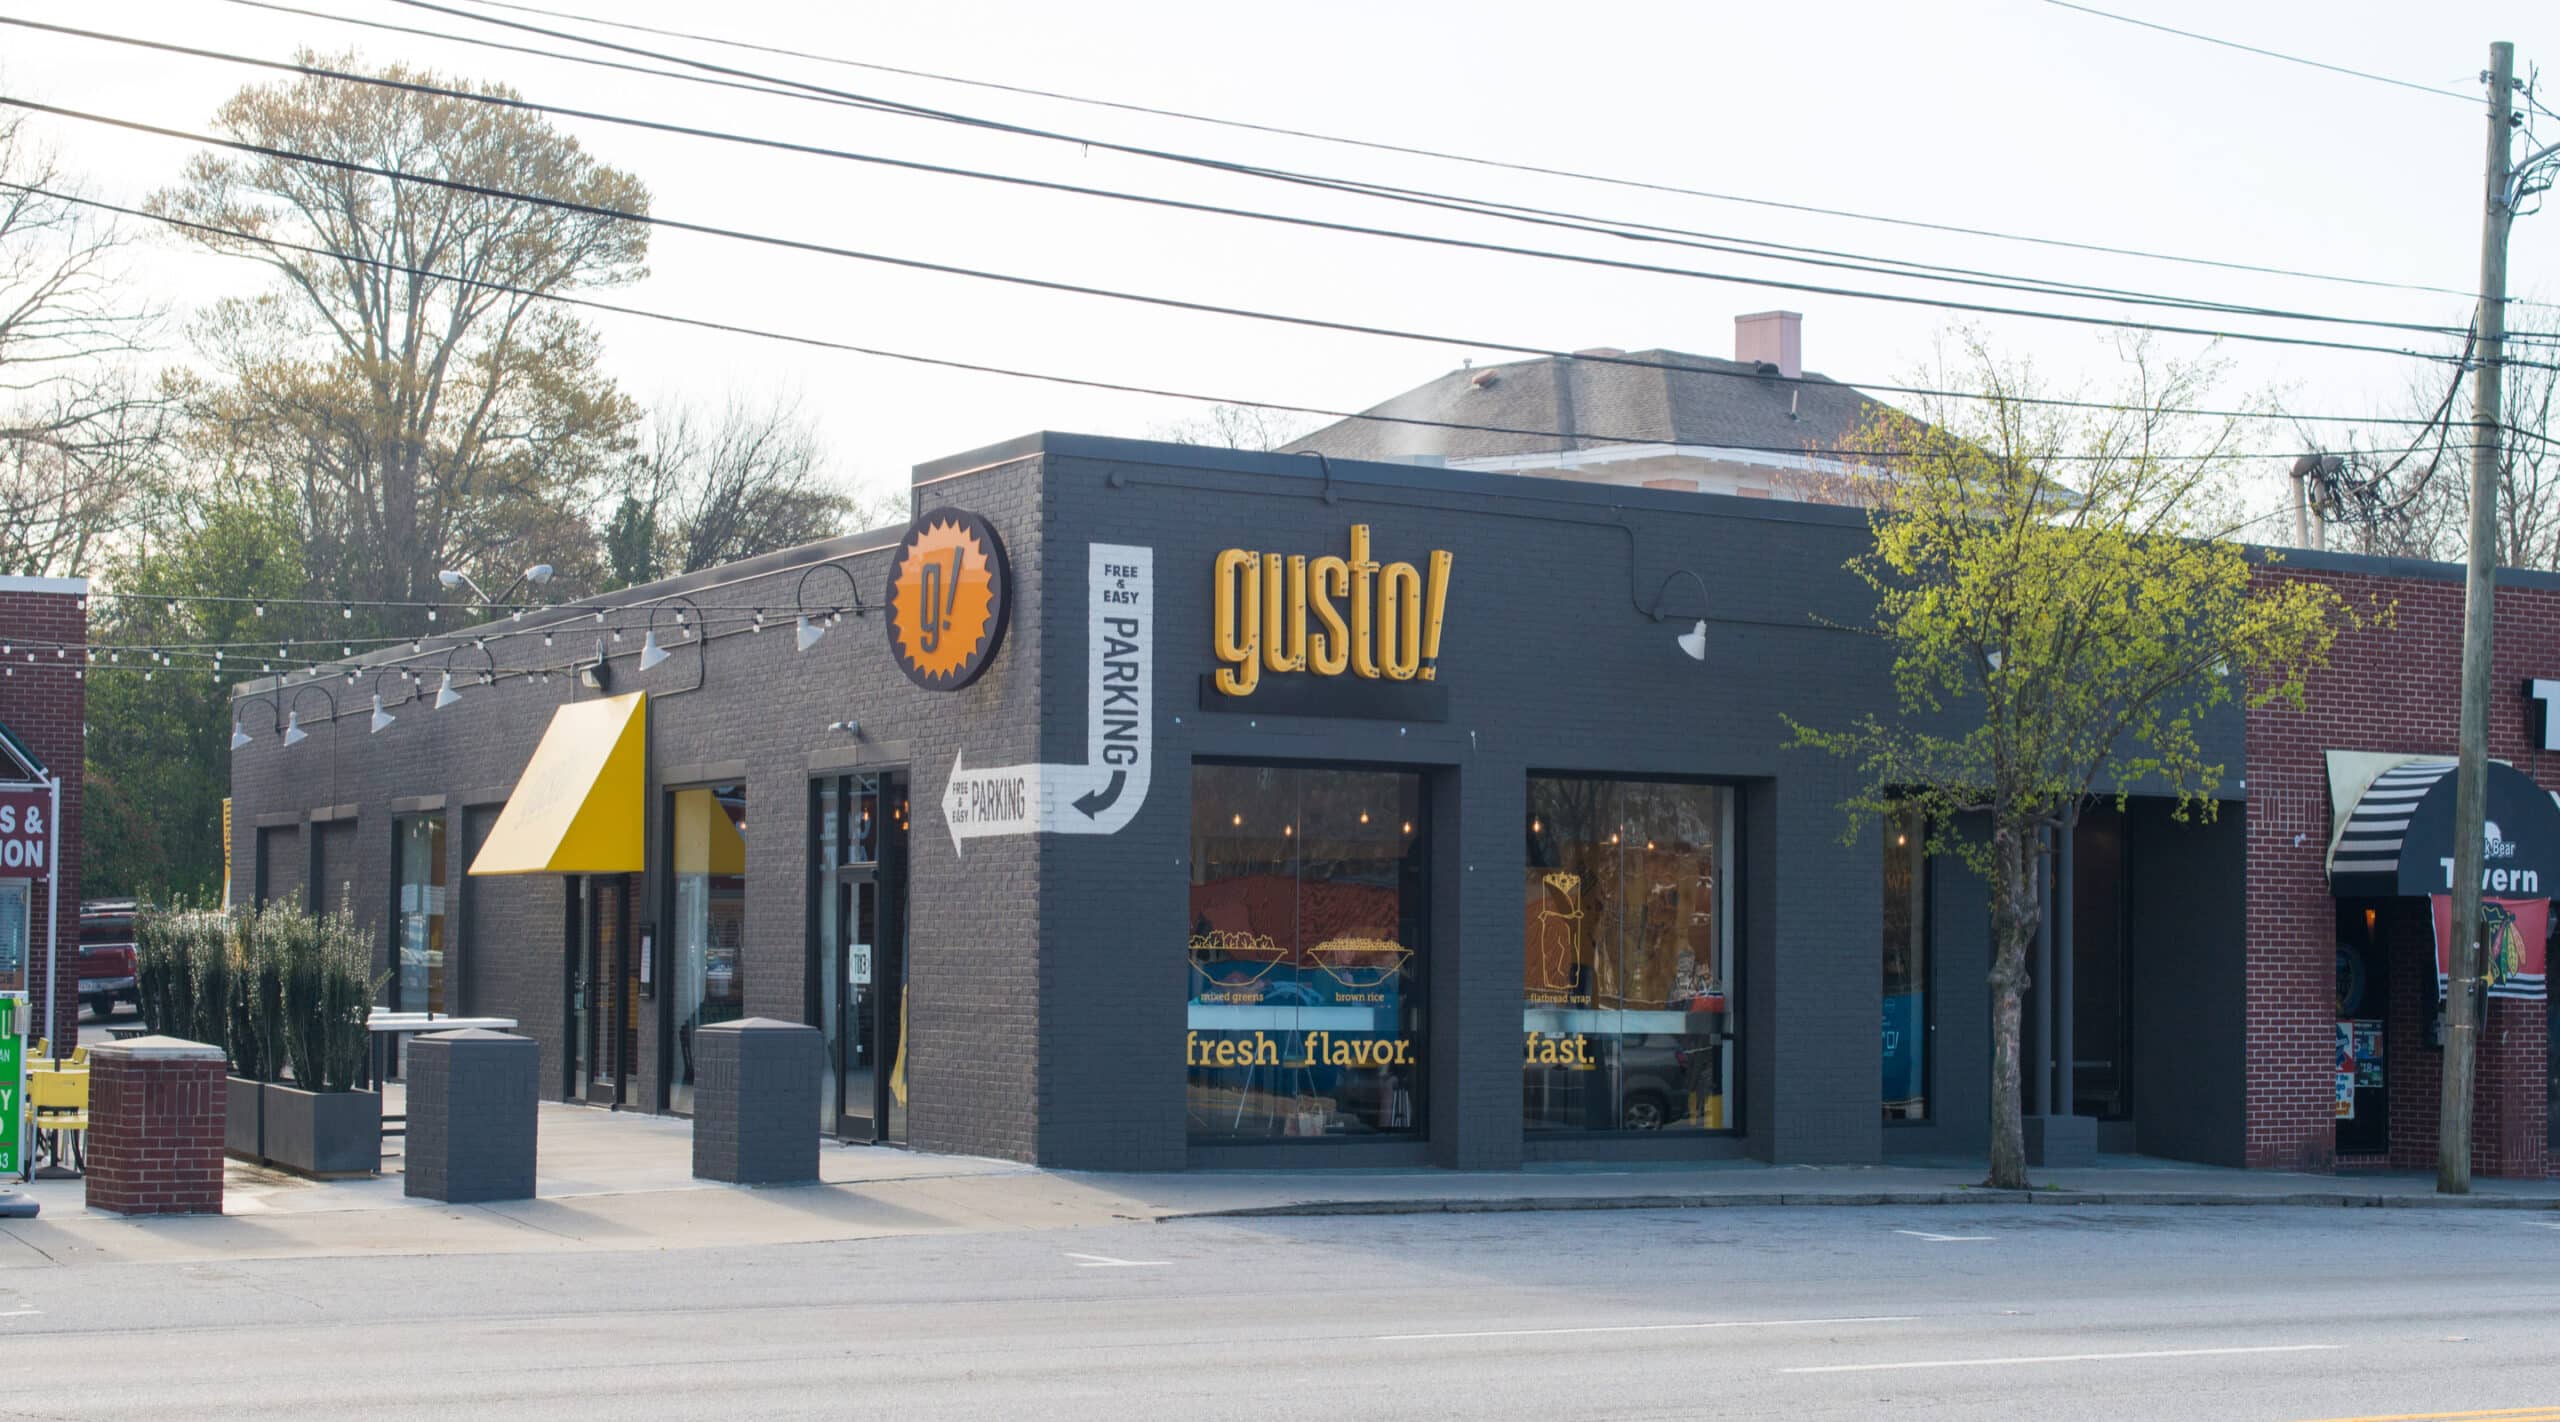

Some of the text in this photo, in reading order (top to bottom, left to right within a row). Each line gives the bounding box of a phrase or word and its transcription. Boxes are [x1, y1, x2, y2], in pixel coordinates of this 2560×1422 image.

[1104, 563, 1139, 578] FREE
[1116, 579, 1125, 589] &
[921, 546, 965, 654] g!
[1103, 589, 1140, 604] EASY
[1214, 524, 1453, 696] gusto!
[1102, 616, 1140, 766] PARKING
[952, 780, 969, 795] FREE
[971, 776, 1025, 823] PARKING
[952, 809, 969, 824] EASY
[2493, 839, 2516, 858] Bear
[1200, 991, 1265, 1005] mixed greens
[1335, 991, 1385, 1002] brown rice
[1529, 992, 1591, 1006] flatbread wrap
[1186, 1030, 1415, 1066] fresh flavor.
[1526, 1030, 1595, 1064] fast.
